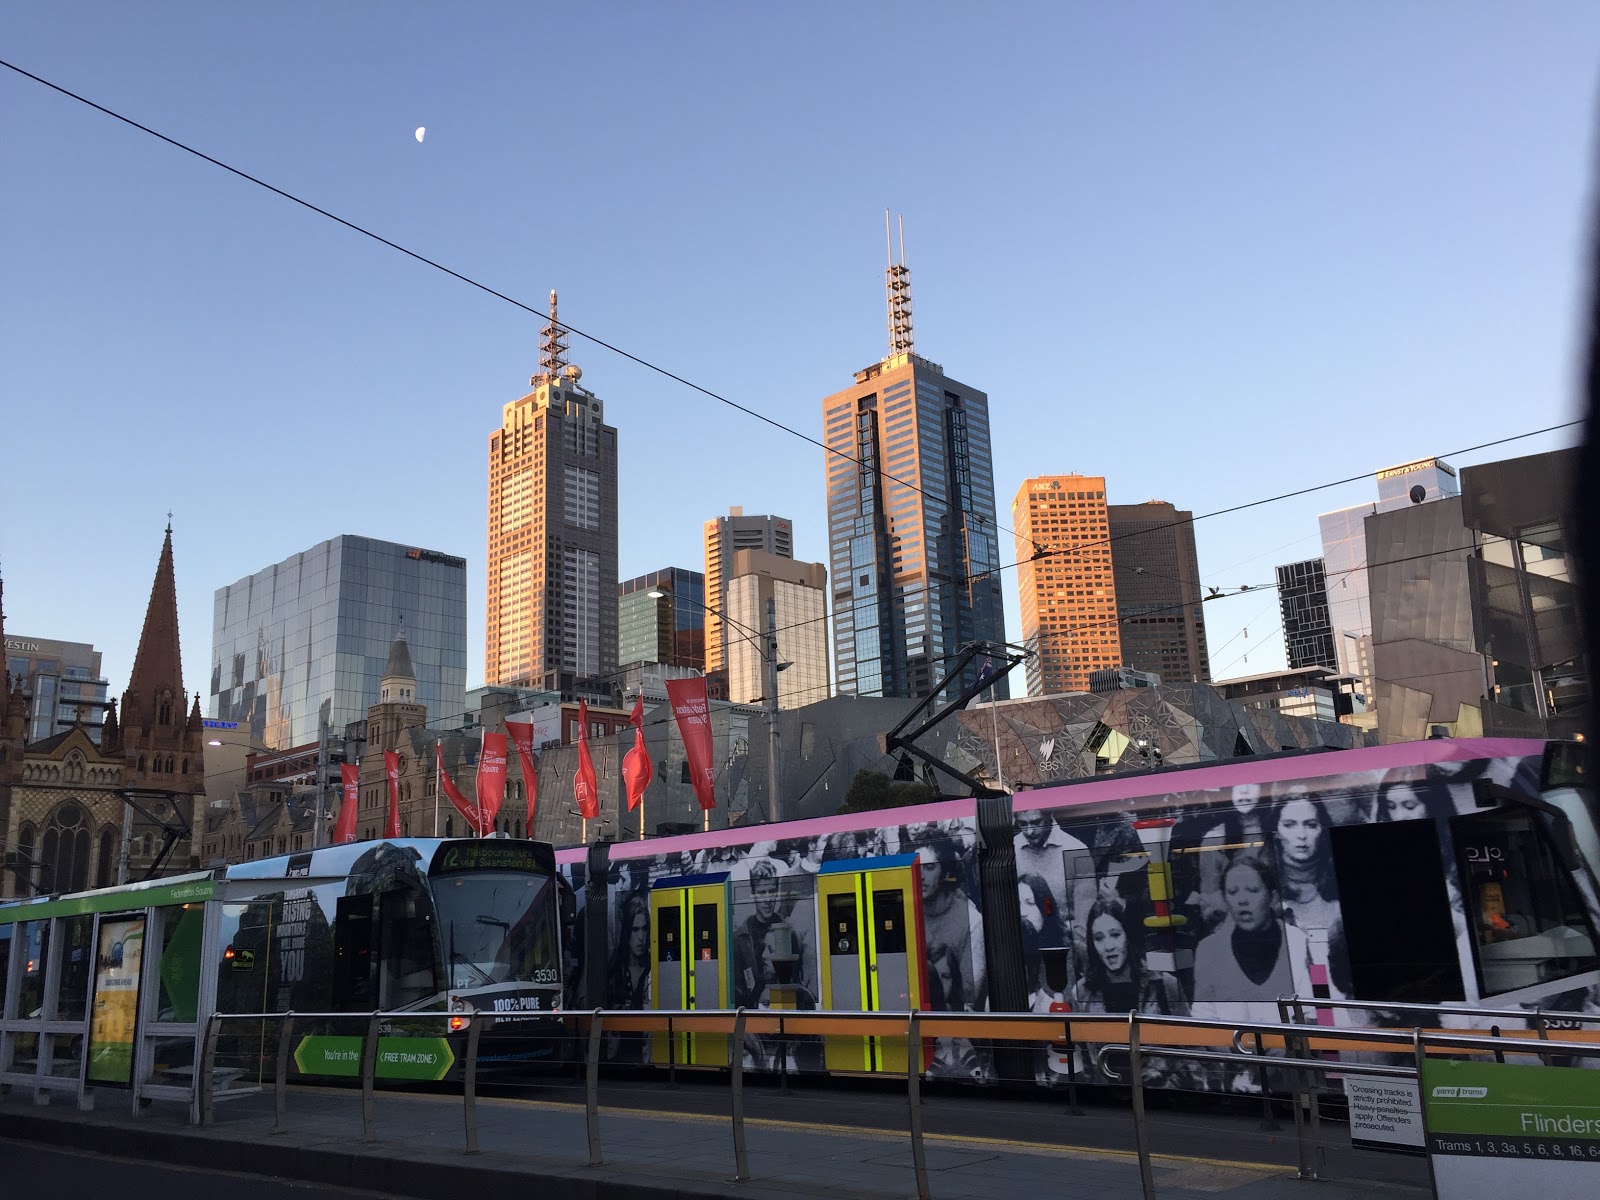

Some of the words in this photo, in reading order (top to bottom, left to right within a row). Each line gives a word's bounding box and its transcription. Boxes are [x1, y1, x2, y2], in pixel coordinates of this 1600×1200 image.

[481, 764, 500, 774] Square
[1040, 760, 1059, 772] SBS
[460, 859, 476, 868] via
[480, 858, 522, 868] Swanston
[195, 886, 213, 896] Square
[282, 899, 312, 922] RISING
[280, 950, 304, 982] YOU
[534, 968, 558, 982] 3530
[493, 998, 520, 1012] 100%
[520, 997, 540, 1010] PURE
[378, 1024, 392, 1033] 530
[324, 1050, 342, 1060] You're
[342, 1050, 348, 1060] in
[348, 1050, 358, 1061] the
[384, 1053, 399, 1062] FREE
[400, 1054, 416, 1064] TRAM
[416, 1054, 432, 1064] ZONE
[1352, 1084, 1382, 1096] Crossing
[1384, 1088, 1406, 1097] tracks
[1406, 1090, 1413, 1098] is
[1353, 1095, 1374, 1106] strictly
[1376, 1096, 1414, 1106] prohibited.
[1354, 1102, 1375, 1113] Heavy
[1376, 1106, 1408, 1115] penalties
[1354, 1112, 1376, 1121] apply.
[1376, 1114, 1412, 1124] Offenders
[1520, 1112, 1600, 1134] Flinders
[1356, 1122, 1396, 1132] prosecuted.
[1436, 1139, 1472, 1152] Trams
[1475, 1141, 1484, 1153] 1,
[1486, 1141, 1498, 1154] 3,
[1502, 1142, 1520, 1154] 3a,
[1524, 1142, 1534, 1156] 5,
[1538, 1144, 1550, 1156] 6,
[1552, 1144, 1564, 1157] 8,
[1568, 1145, 1586, 1158] 16,
